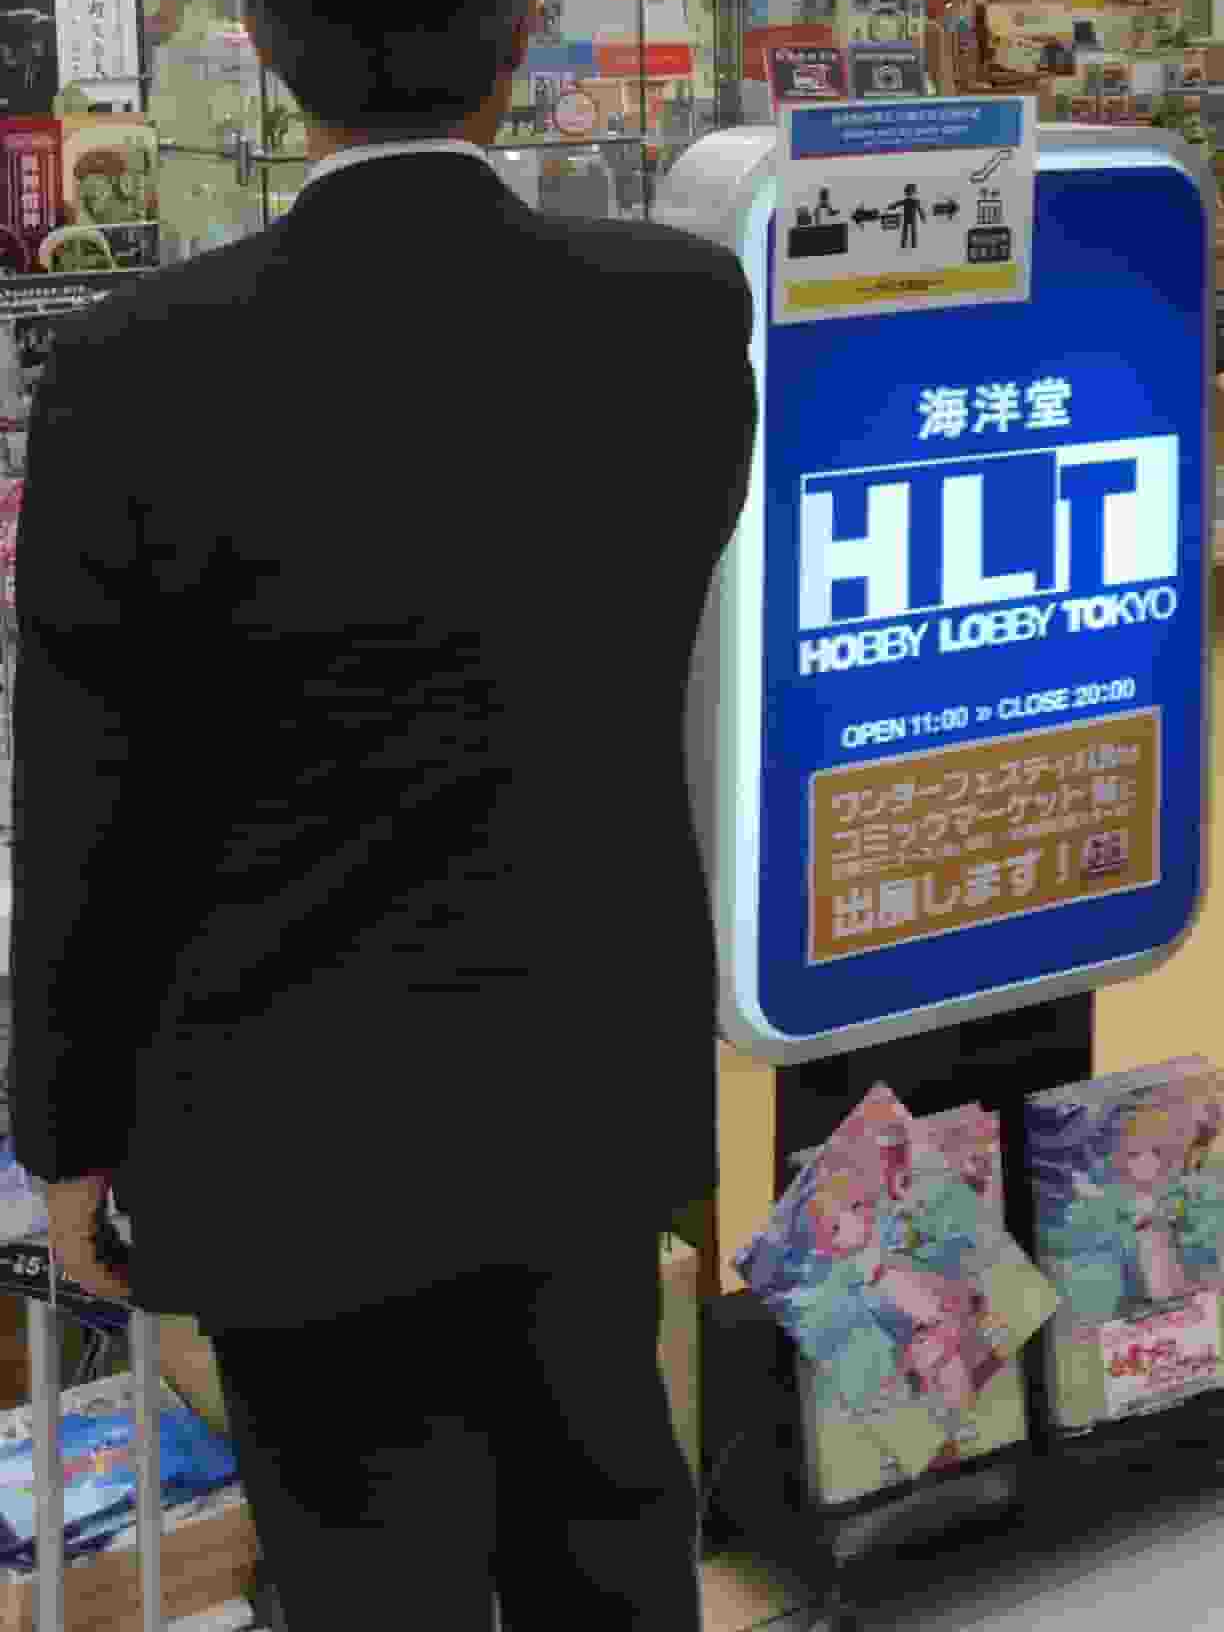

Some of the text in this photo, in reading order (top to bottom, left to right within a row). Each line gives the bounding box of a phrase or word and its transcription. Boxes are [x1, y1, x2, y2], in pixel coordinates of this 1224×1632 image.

[916, 376, 1072, 441] 海洋堂
[800, 435, 1179, 631] HLT
[799, 586, 1178, 676] HOBBY LOBBY TOKYO
[841, 676, 1137, 749] OPEN 11:00 CLOSE 20:00
